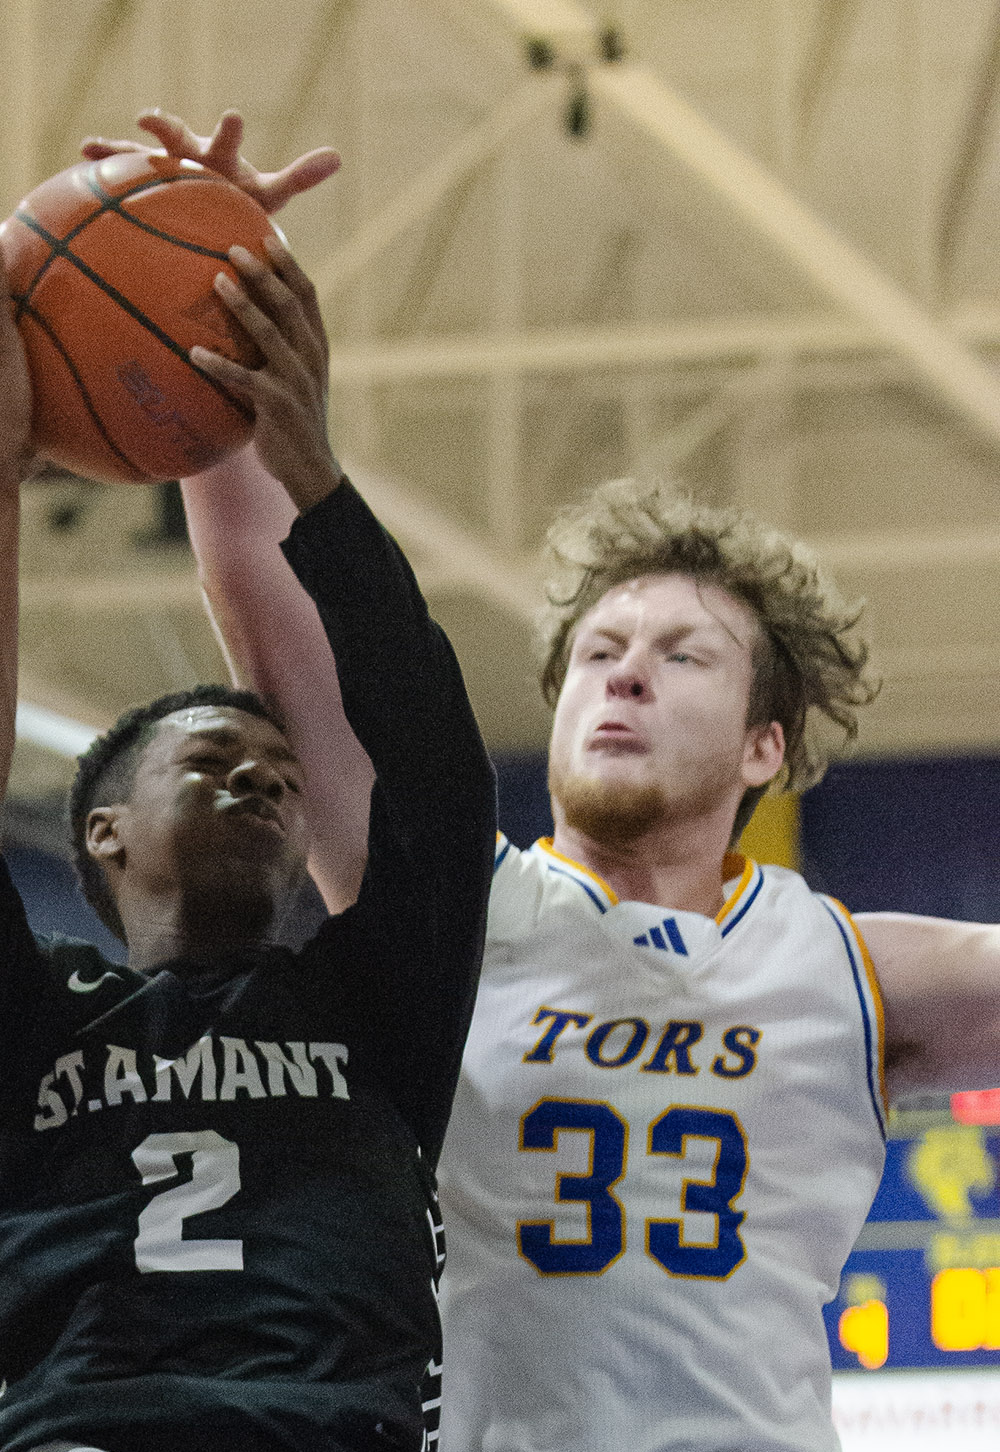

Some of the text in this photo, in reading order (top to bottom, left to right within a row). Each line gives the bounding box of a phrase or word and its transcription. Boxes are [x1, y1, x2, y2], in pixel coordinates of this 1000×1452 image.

[521, 1005, 764, 1079] TORS
[130, 1128, 245, 1274] 2
[515, 1096, 749, 1282] 33
